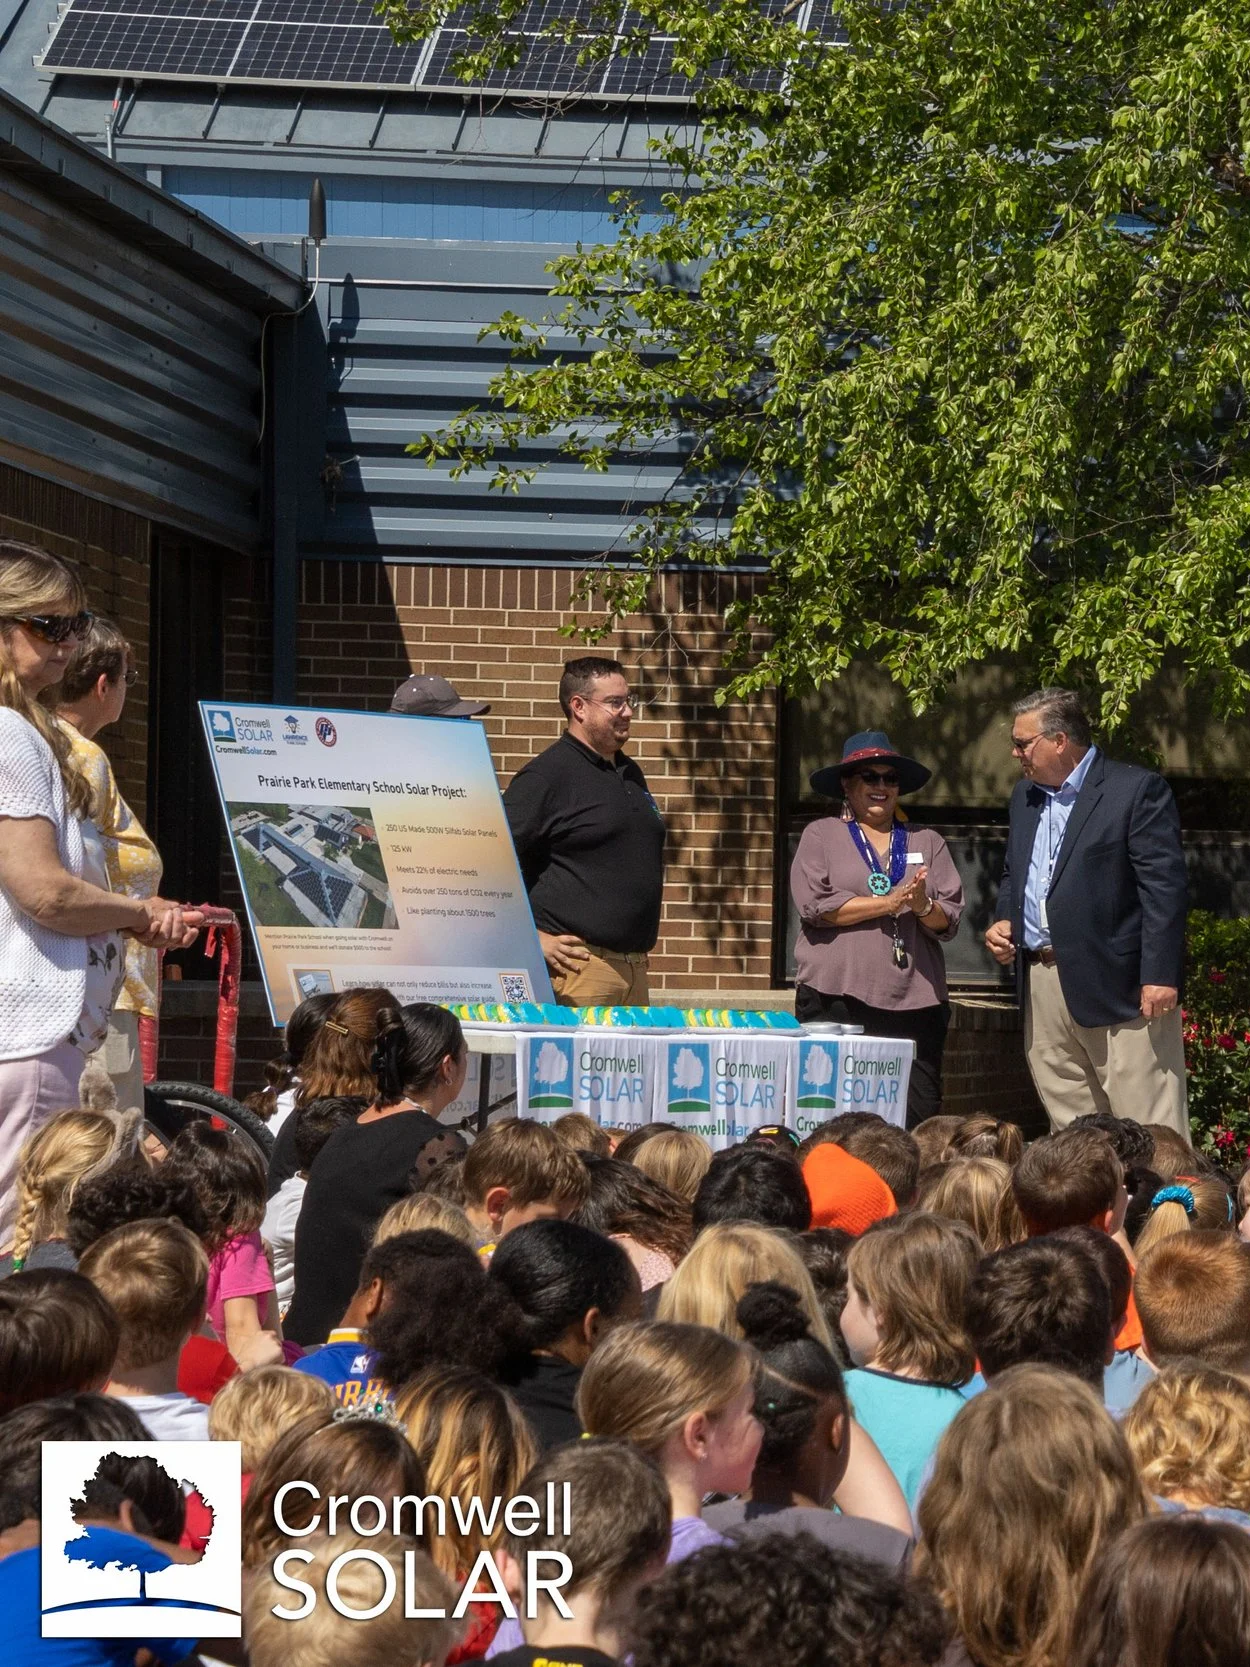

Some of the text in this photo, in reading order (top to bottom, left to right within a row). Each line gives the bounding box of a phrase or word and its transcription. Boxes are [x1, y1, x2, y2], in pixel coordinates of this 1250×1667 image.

[235, 717, 270, 728] Cromwell
[238, 728, 274, 742] SOLAR
[215, 745, 277, 756] CromwellSolar.com
[258, 775, 467, 799] Prairie Park Elementary School Solar Project:
[478, 830, 498, 838] Panels
[436, 867, 459, 875] electric
[421, 908, 446, 917] planting
[580, 1051, 643, 1074] Cromwell
[716, 1057, 775, 1080] Cromwell
[844, 1055, 901, 1076] Cromwell
[579, 1075, 643, 1103] SOLAR
[716, 1081, 775, 1109] SOLAR
[842, 1078, 899, 1104] SOLAR
